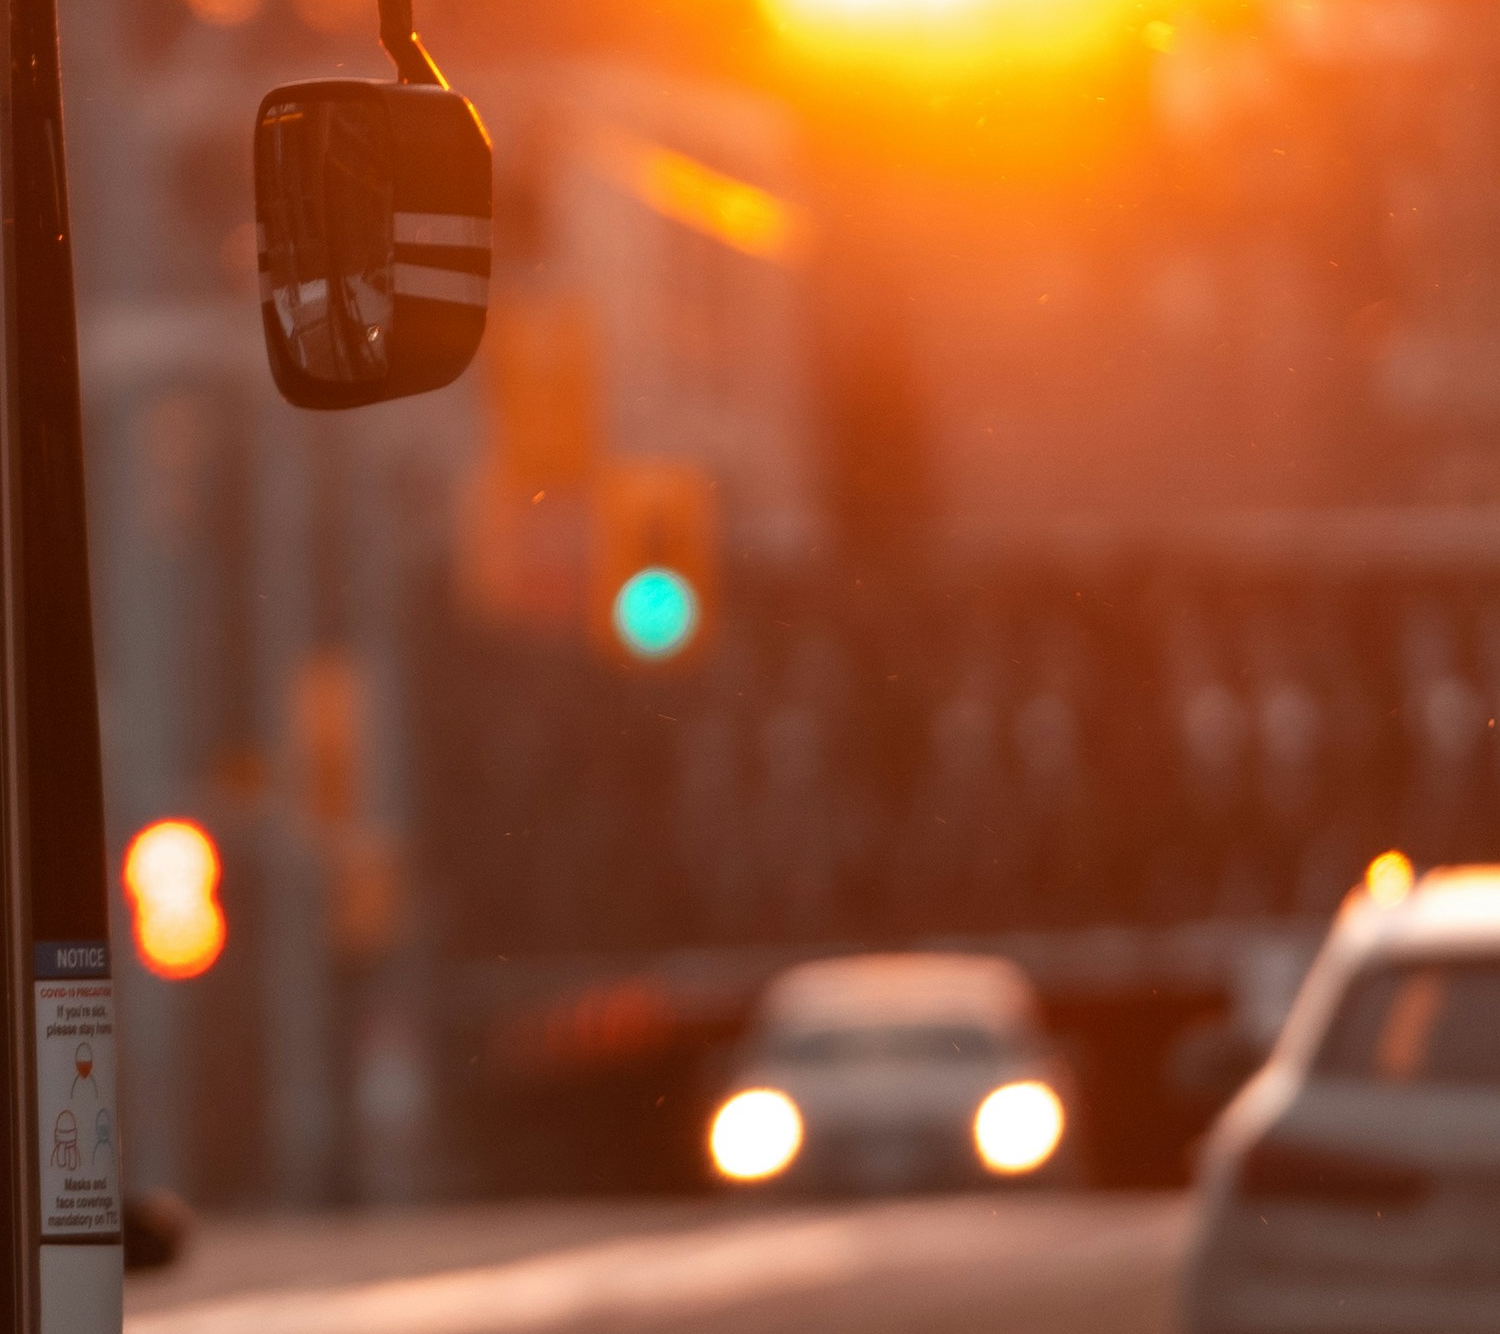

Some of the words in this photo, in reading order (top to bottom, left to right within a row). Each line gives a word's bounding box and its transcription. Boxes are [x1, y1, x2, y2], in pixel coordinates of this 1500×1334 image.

[56, 948, 105, 968] NOTICE
[46, 1022, 77, 1039] please
[78, 1022, 95, 1037] stay
[64, 1177, 91, 1191] Masks
[47, 1212, 93, 1229] mandatory
